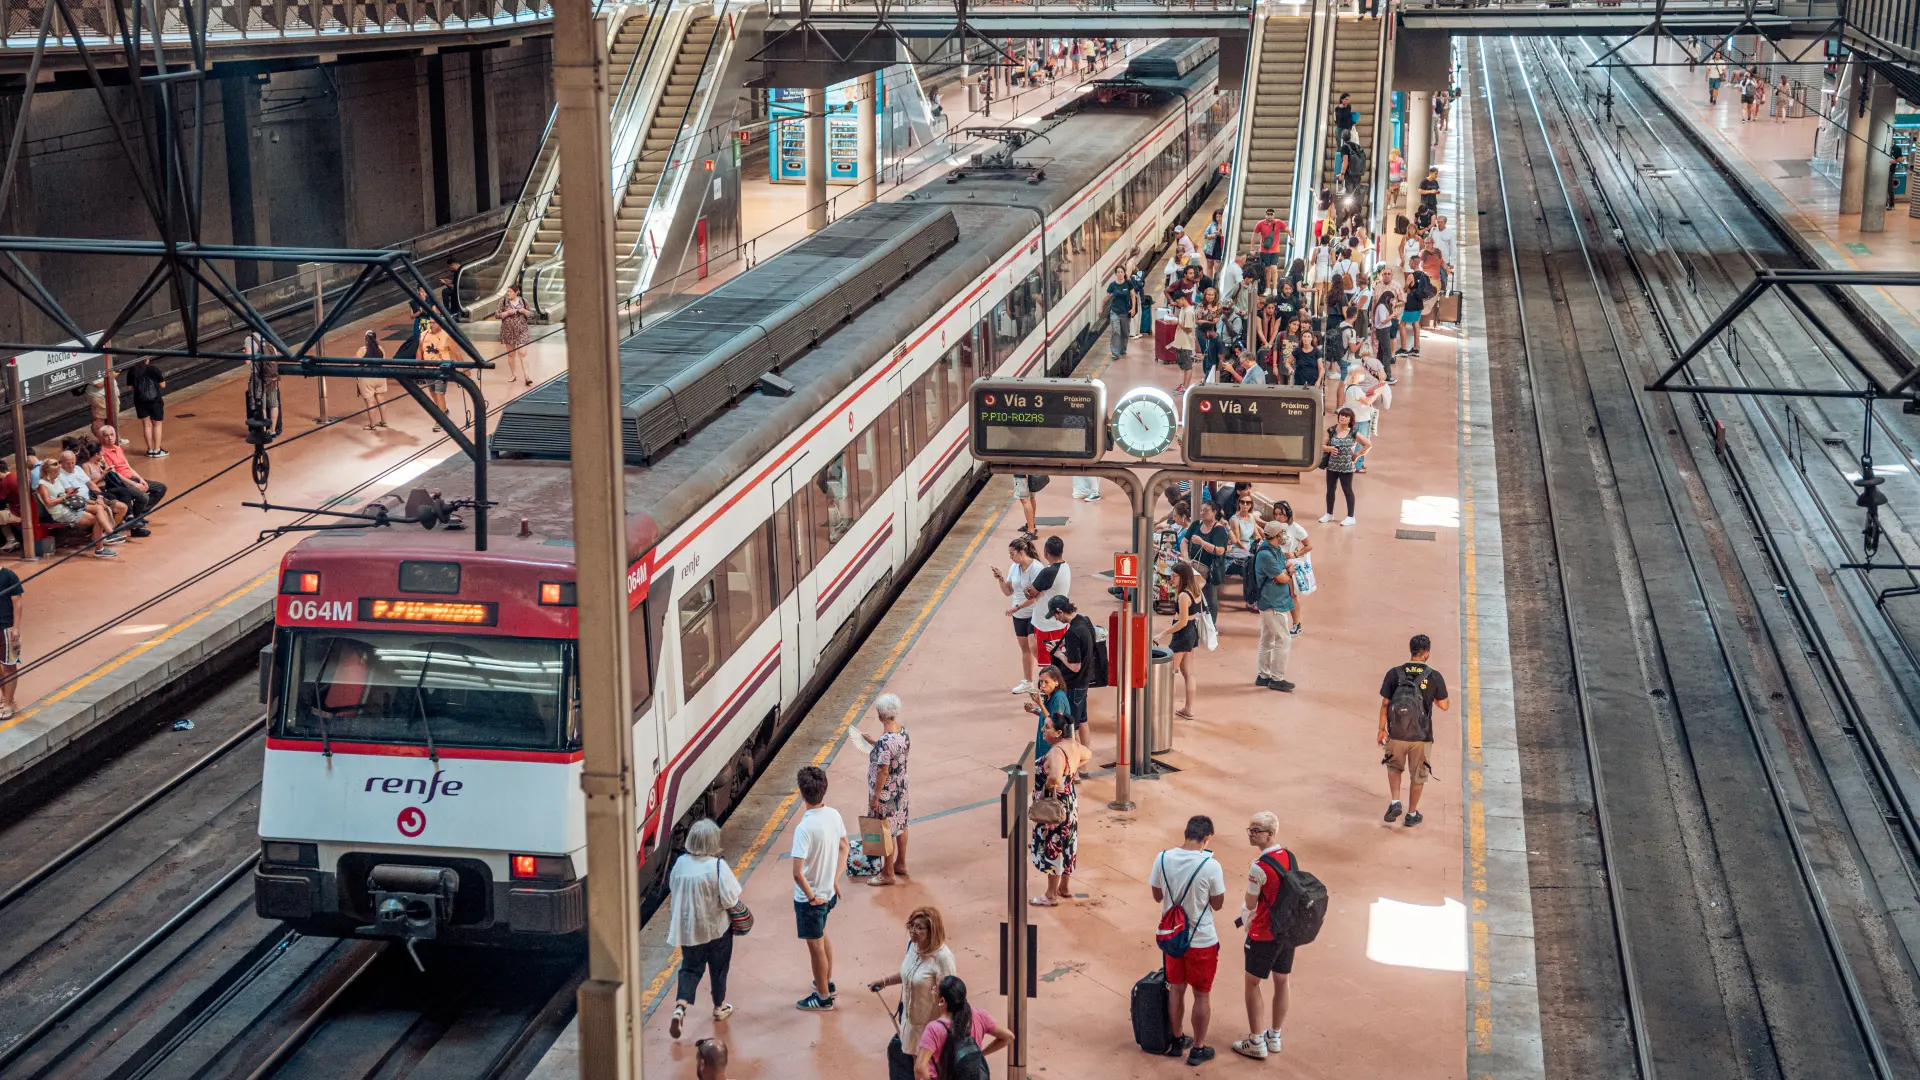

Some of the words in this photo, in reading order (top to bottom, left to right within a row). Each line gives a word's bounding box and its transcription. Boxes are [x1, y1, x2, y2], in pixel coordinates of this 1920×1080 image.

[1004, 394, 1027, 408] Vía
[1034, 395, 1044, 408] 3
[1063, 395, 1092, 403] Próximo
[1218, 400, 1242, 414] Vía
[1248, 401, 1258, 415] 4
[1281, 402, 1310, 410] Próximo
[681, 551, 700, 580] renfe
[627, 562, 647, 593] 064M
[288, 600, 353, 622] 064M
[364, 769, 464, 804] renfe
